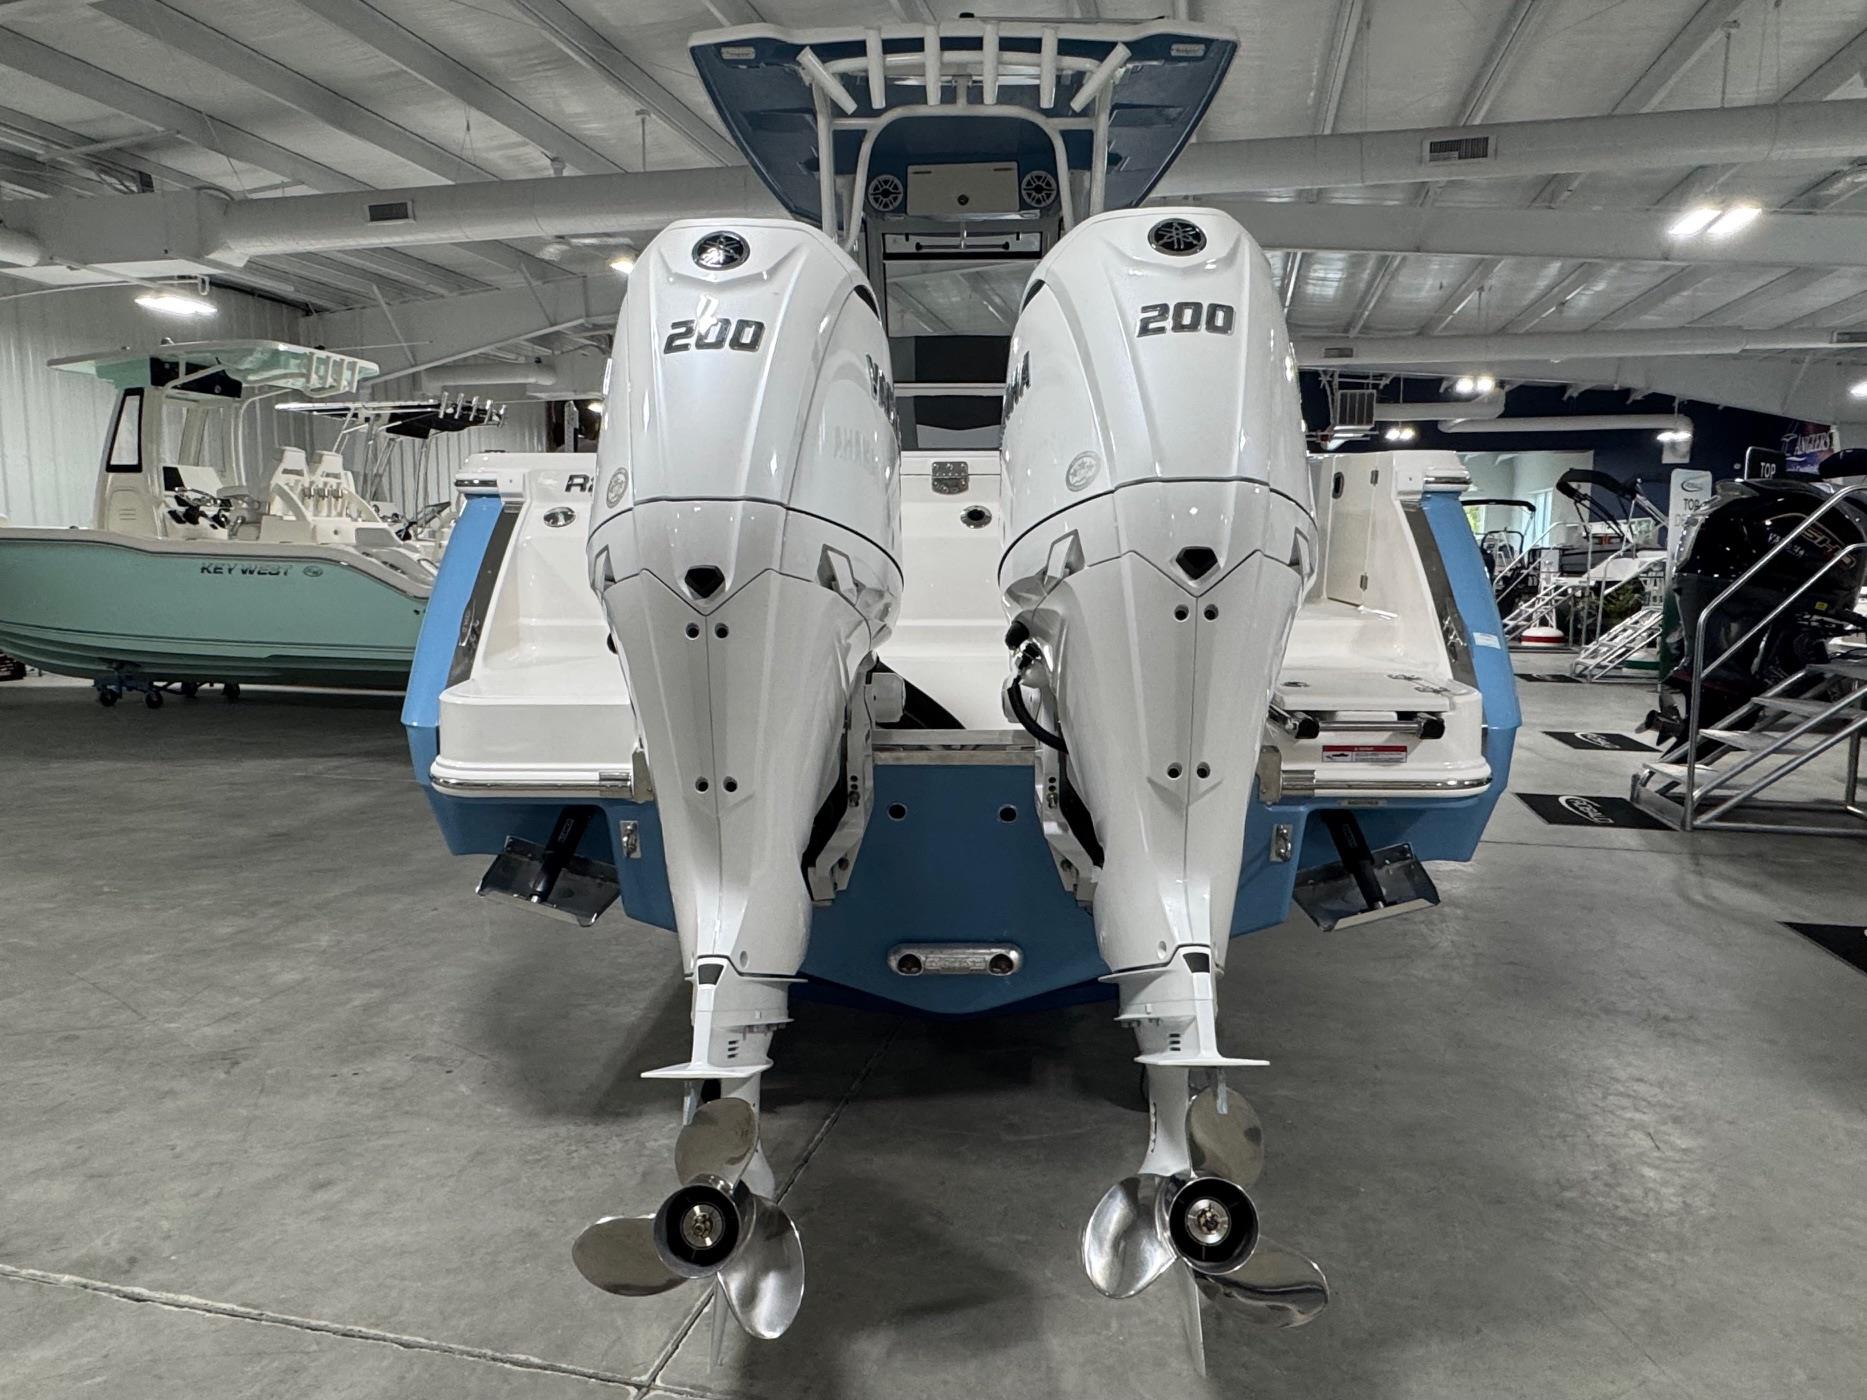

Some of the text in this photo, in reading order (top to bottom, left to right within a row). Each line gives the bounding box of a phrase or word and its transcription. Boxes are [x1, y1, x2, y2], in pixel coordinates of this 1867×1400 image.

[1136, 301, 1236, 338] 200
[663, 317, 766, 355] 200
[1760, 462, 1776, 479] TOP
[200, 562, 237, 574] KEY
